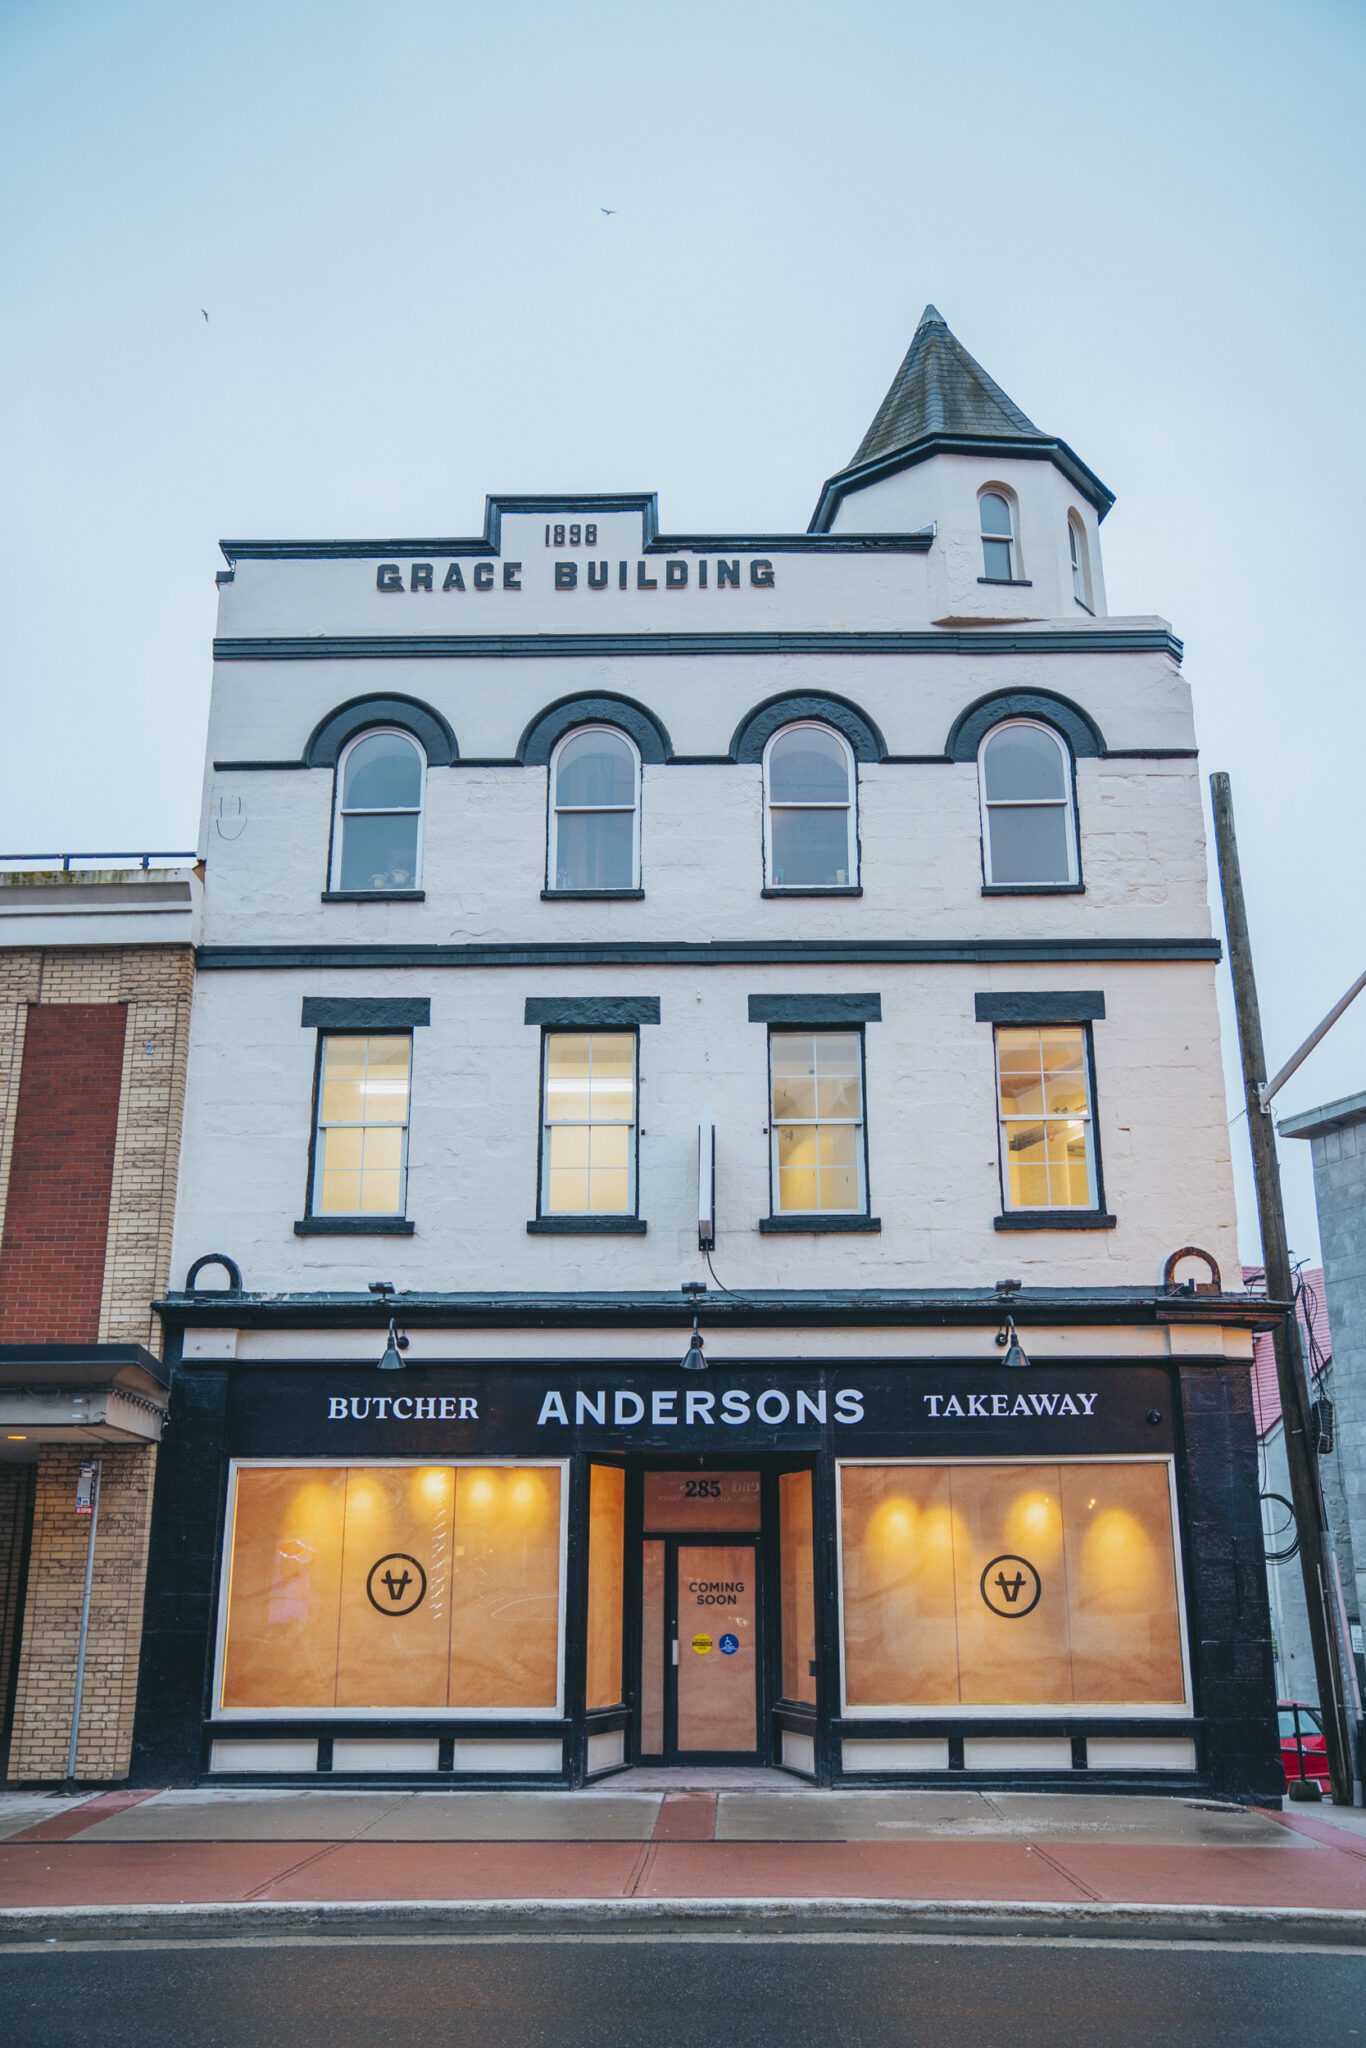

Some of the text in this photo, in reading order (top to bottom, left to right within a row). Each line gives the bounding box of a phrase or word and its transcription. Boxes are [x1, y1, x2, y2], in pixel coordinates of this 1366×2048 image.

[545, 524, 597, 547] 1898
[376, 559, 775, 593] GRACE BUILDING
[327, 1397, 479, 1420] BUTCHER
[537, 1390, 864, 1425] ANDERSONS
[924, 1393, 1098, 1417] TAKEAWAY
[685, 1480, 721, 1497] 285
[689, 1582, 744, 1593] COMING
[697, 1595, 736, 1605] SOON
